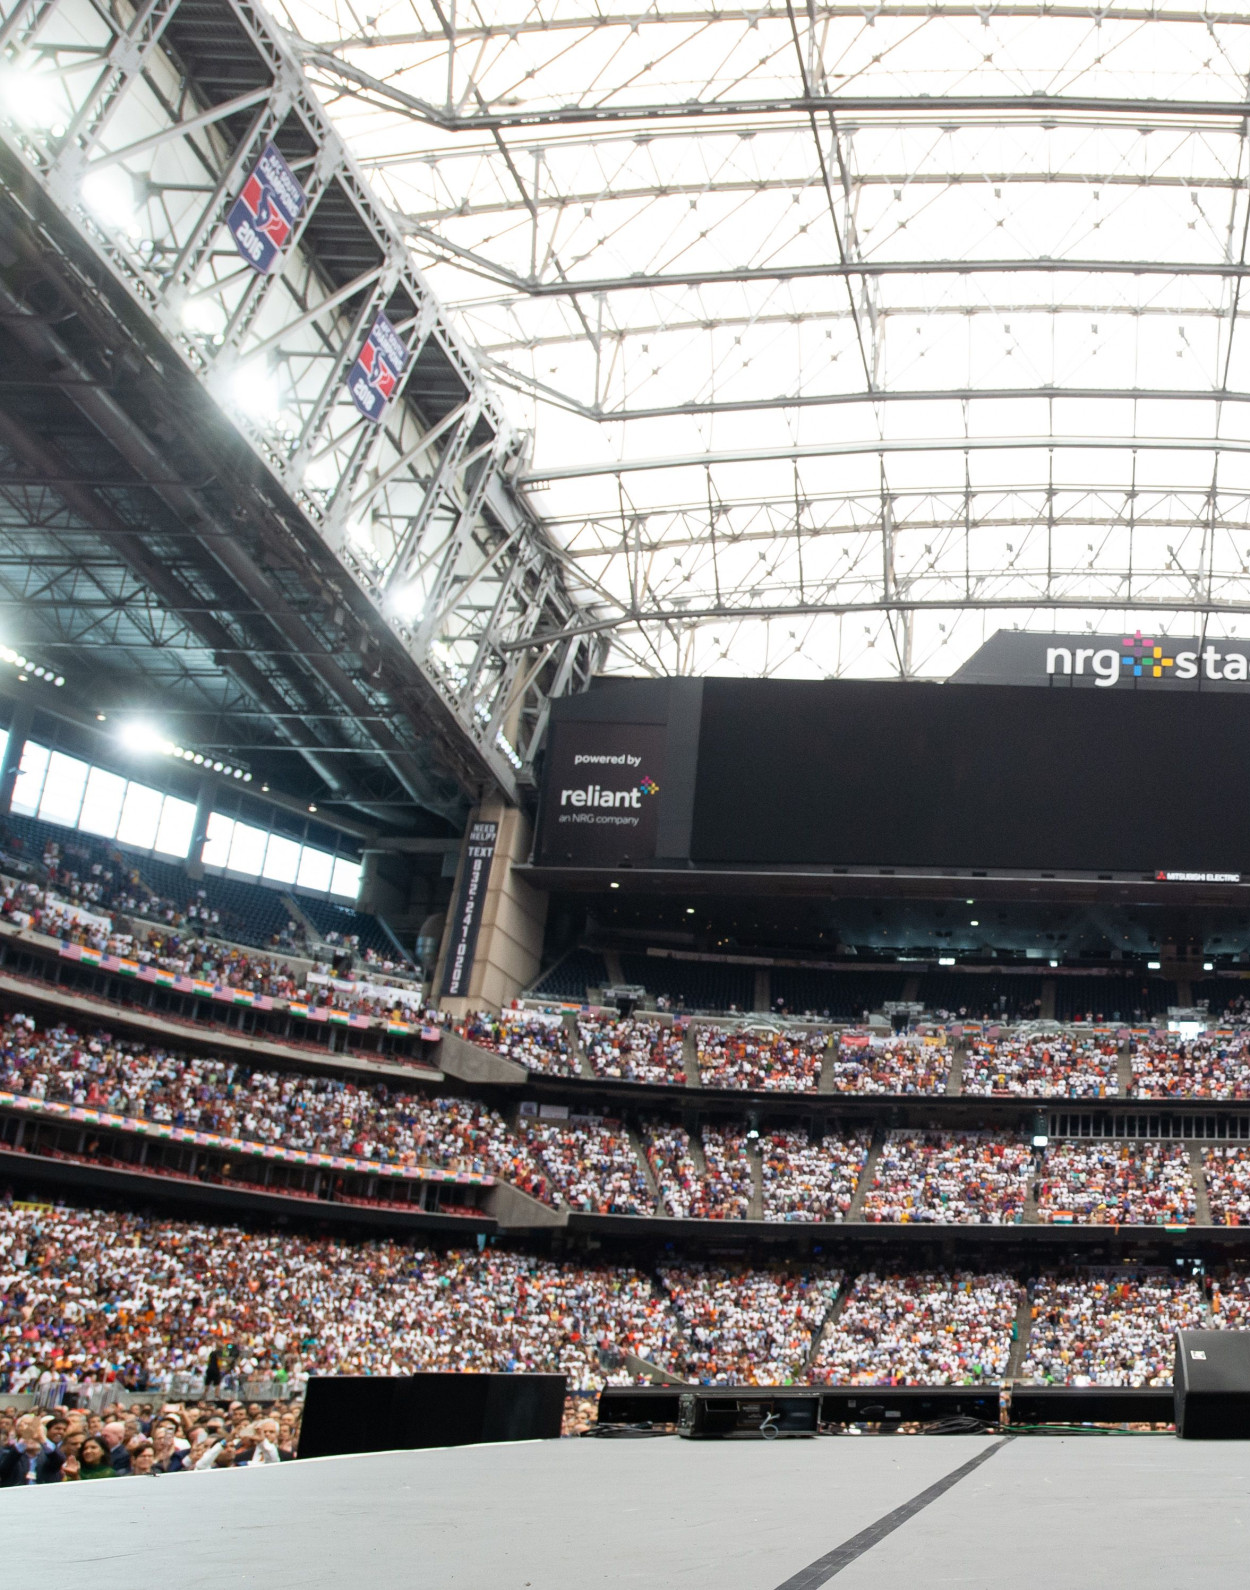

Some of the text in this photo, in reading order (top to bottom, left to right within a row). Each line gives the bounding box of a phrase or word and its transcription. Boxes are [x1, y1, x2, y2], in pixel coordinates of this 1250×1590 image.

[260, 157, 300, 218] CHAMPIONS
[236, 220, 264, 261] 2016
[1046, 647, 1120, 687] nrg
[574, 754, 642, 767] powered by
[560, 785, 642, 808] reliant
[558, 813, 640, 827] an NRG company
[473, 824, 496, 833] NEED
[469, 832, 497, 842] HELP?
[468, 846, 494, 858] TEXT
[1166, 872, 1240, 882] MITSUBISHI ELECTRIC
